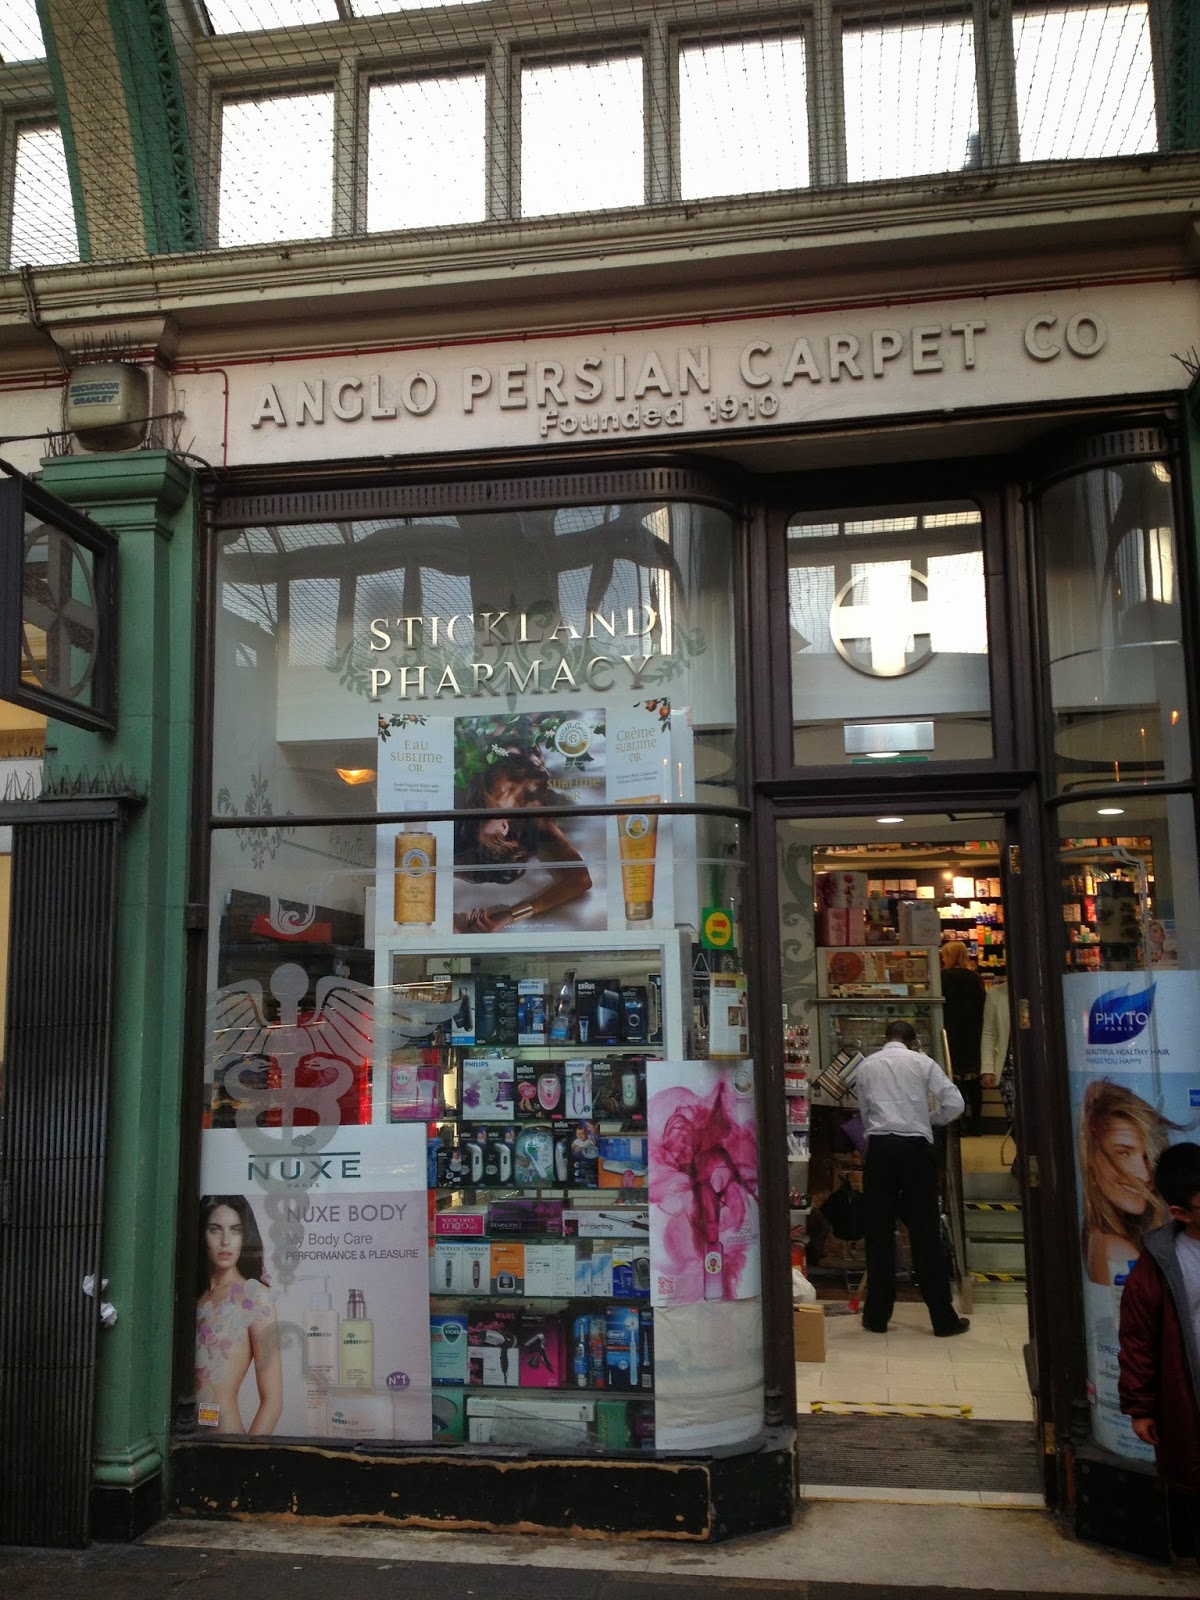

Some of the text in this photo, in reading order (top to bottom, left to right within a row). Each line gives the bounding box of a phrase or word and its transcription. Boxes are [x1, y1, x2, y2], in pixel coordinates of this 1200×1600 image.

[250, 311, 1109, 428] ANGLO PERSIAN CARPET CO
[539, 391, 779, 437] Founded 1910
[369, 605, 657, 652] STICKLAND
[368, 654, 654, 702] PHARMACY
[1095, 1012, 1148, 1025] PHYTO
[1116, 1048, 1149, 1056] HEALTHY
[1119, 1057, 1142, 1065] HAPPY
[247, 1159, 361, 1181] NUXE
[287, 1203, 408, 1223] NUXE BODY
[589, 1223, 613, 1231] curling
[286, 1232, 373, 1248] My Body Care
[286, 1249, 420, 1261] PERFORMANCE & PLEASURE
